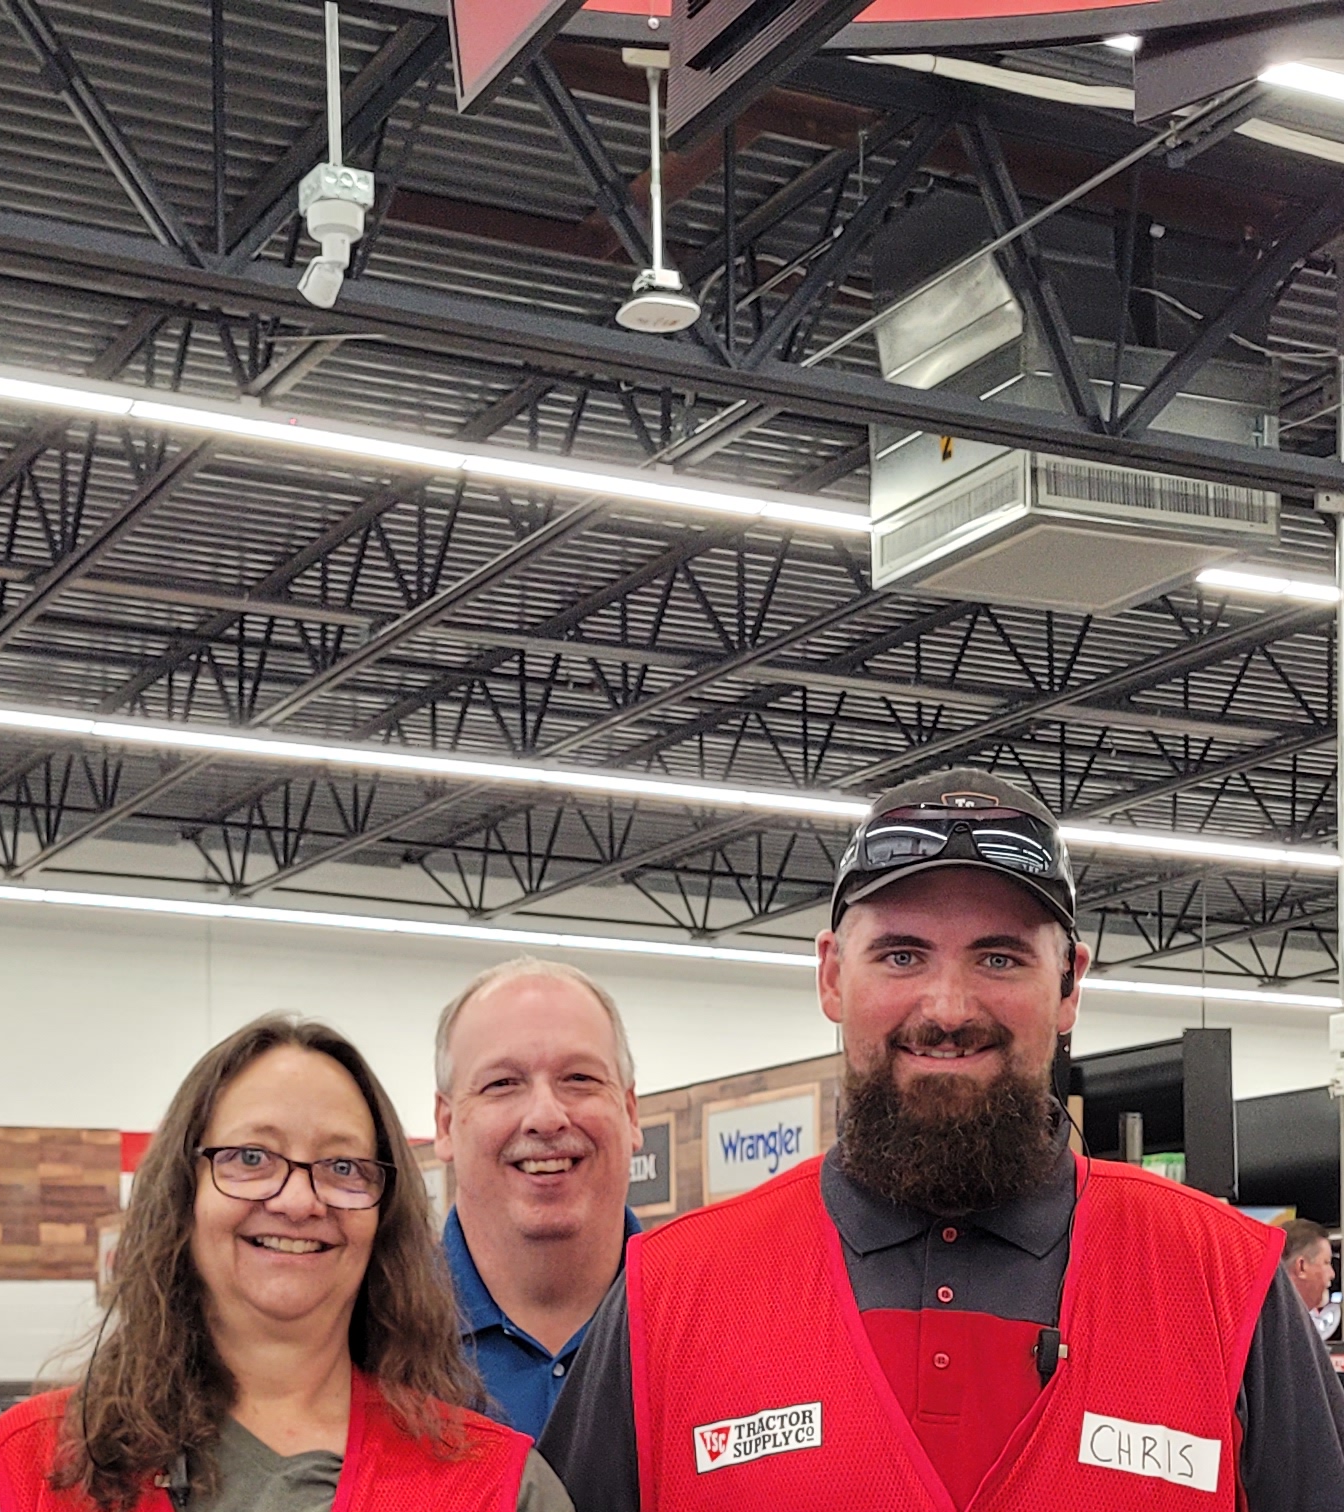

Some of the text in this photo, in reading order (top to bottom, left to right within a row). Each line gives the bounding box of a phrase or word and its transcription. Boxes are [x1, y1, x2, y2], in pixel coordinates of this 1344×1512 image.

[720, 1122, 802, 1173] Wrangler
[701, 1428, 727, 1454] TSC
[734, 1410, 814, 1441] TRACTOR
[733, 1430, 794, 1459] SUPPLY
[1090, 1423, 1196, 1479] CHRIS
